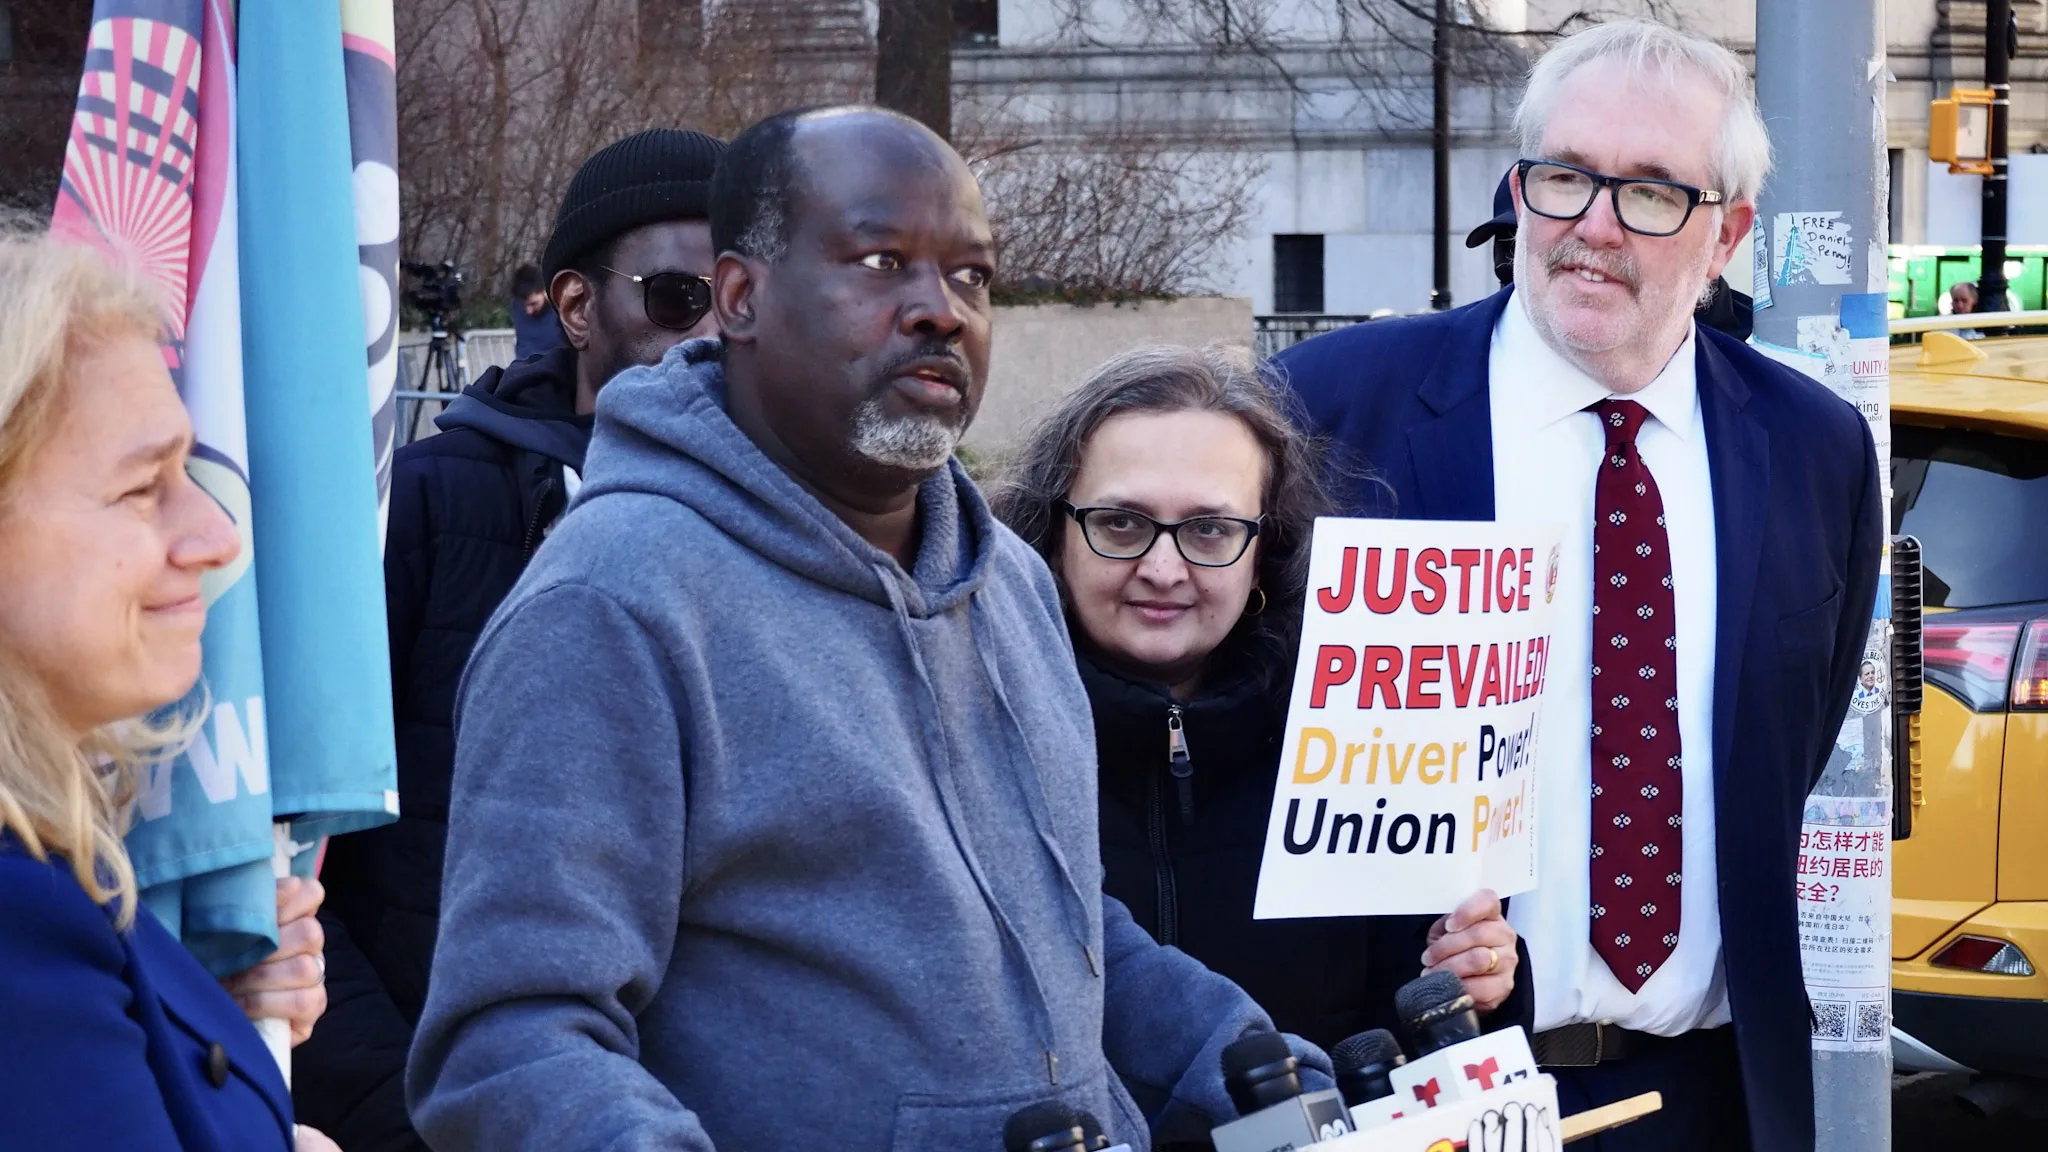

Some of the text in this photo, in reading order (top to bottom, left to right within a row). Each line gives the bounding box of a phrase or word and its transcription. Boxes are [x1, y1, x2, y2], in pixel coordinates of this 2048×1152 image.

[1802, 217, 1834, 230] FREE
[1807, 231, 1846, 246] Daniel
[1853, 360, 1882, 375] UNITY
[1317, 547, 1533, 614] JUSTICE
[1309, 635, 1550, 709] PREVAILED!
[1292, 712, 1534, 784] Driver Power!
[1283, 798, 1456, 854] Union
